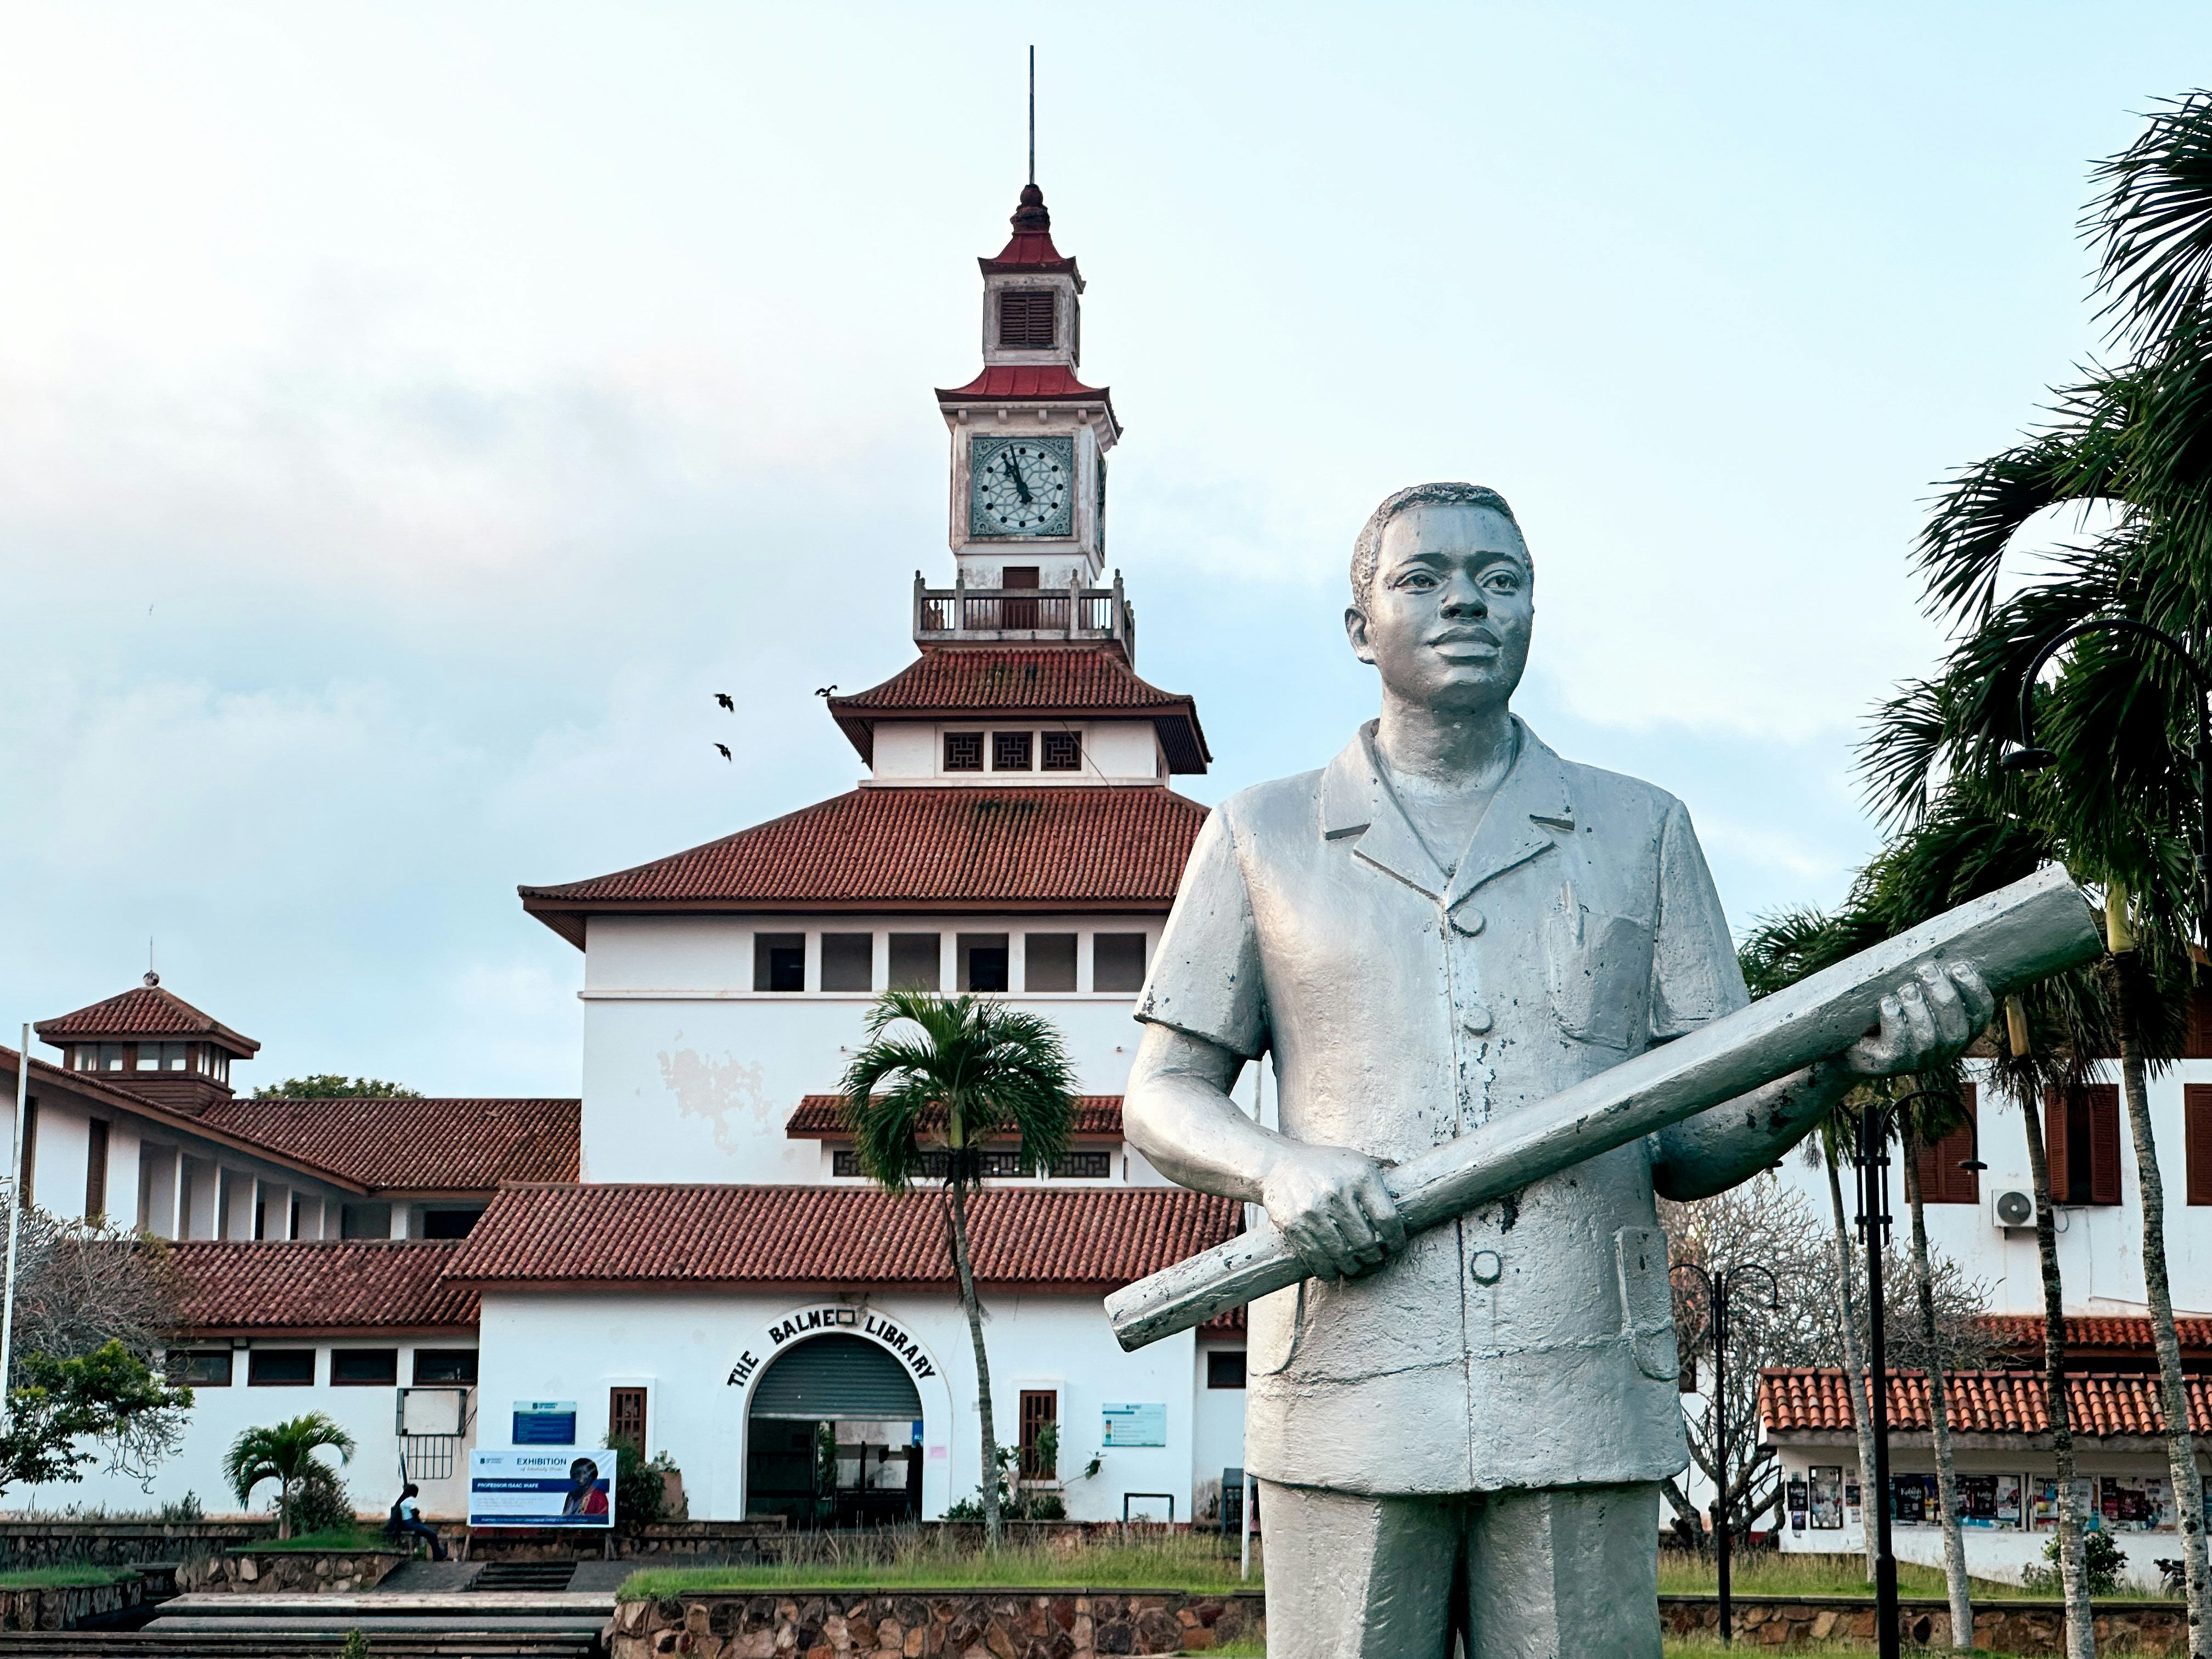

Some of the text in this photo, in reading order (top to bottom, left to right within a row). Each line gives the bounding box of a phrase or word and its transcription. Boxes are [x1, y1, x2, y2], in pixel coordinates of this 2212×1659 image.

[727, 1309, 936, 1387] THE BALME LIBRARY
